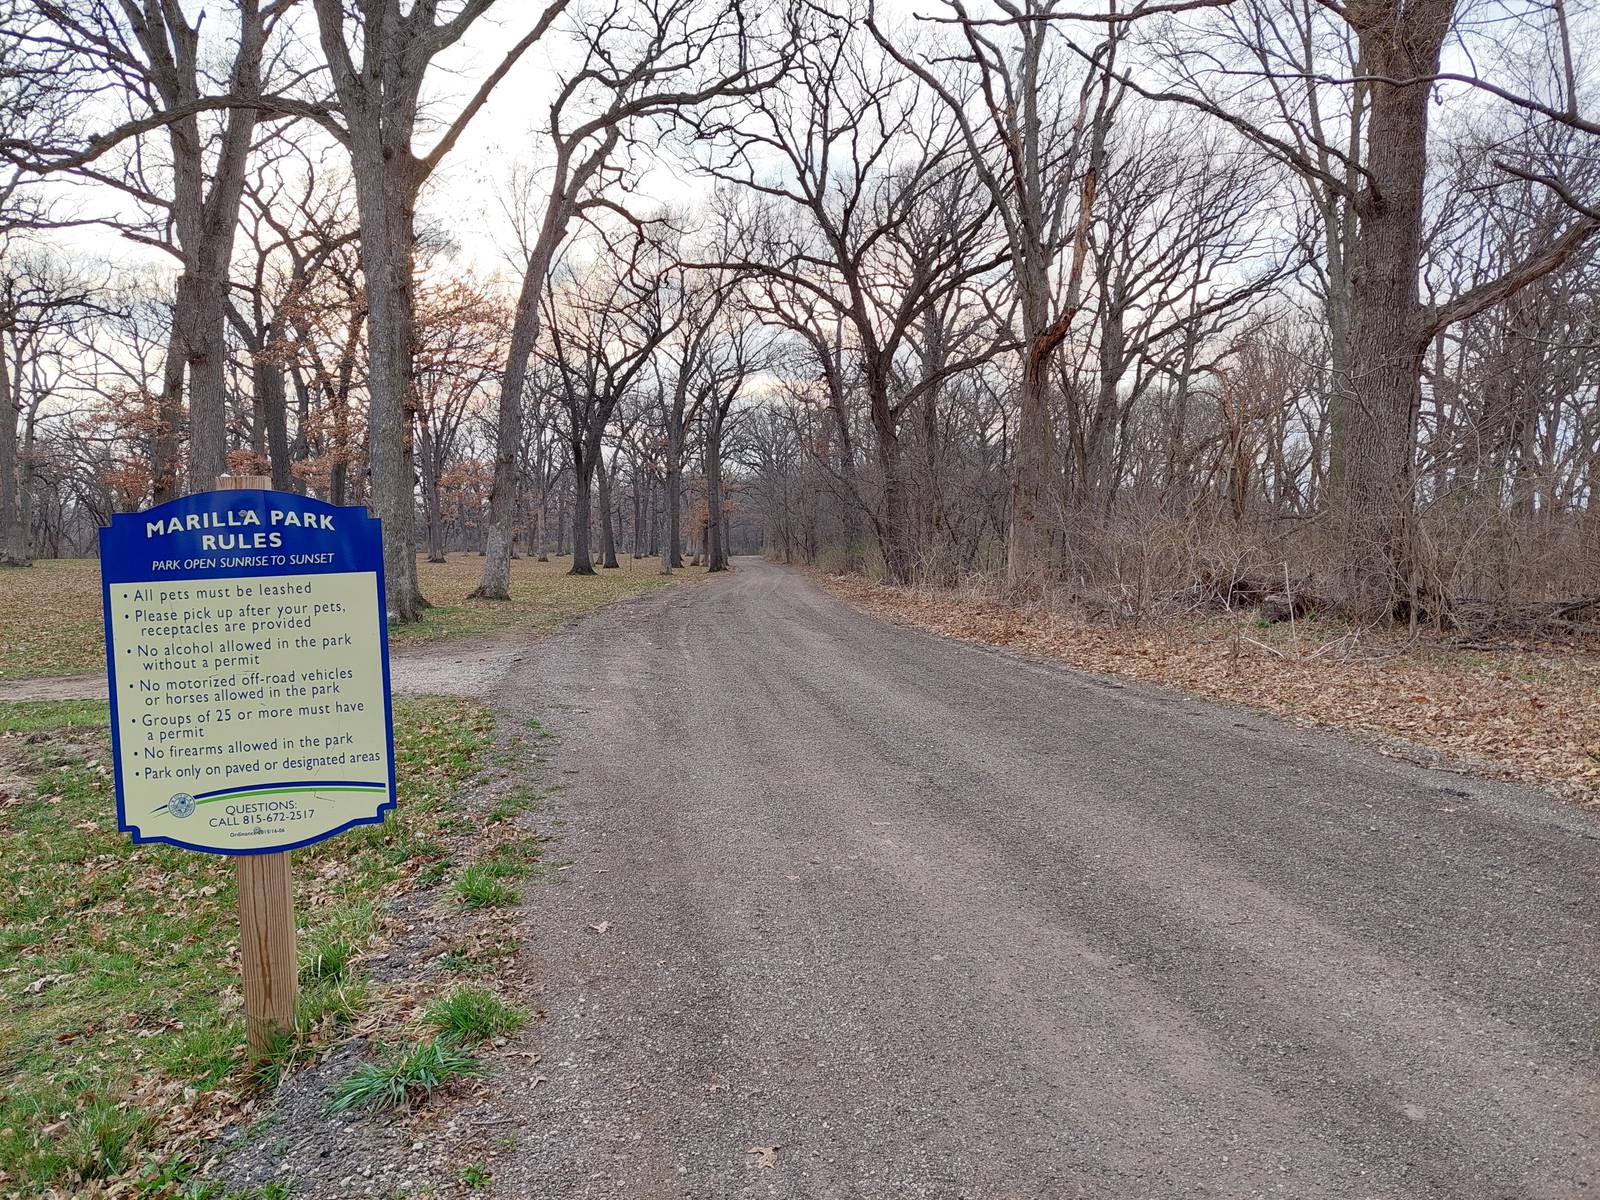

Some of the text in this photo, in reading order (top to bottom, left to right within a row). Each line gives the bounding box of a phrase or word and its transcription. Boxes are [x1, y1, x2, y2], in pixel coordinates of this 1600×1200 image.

[146, 510, 335, 538] MARILLA PARK
[202, 533, 282, 551] RULES
[152, 553, 334, 571] PARK OPEN SUNRISE TO SUNSET
[134, 582, 312, 604] All pets must be leashed
[135, 601, 346, 622] Please pick up after your pets,
[141, 616, 311, 638] receptacles are provided
[137, 635, 351, 657] No alcohol allowed in the park
[143, 655, 260, 671] without a permit
[140, 668, 353, 691] No motorized off-road vehicles
[145, 683, 339, 706] or horses allowed in the park
[143, 700, 364, 728] Groups of 25 or more must have
[144, 733, 353, 759] No firearms allowed in the park
[147, 727, 204, 743] a permit
[145, 751, 380, 779] Park only on paved or designated areas
[209, 809, 315, 828] CALL 815-672-2517
[226, 800, 297, 816] QUESTIONS:
